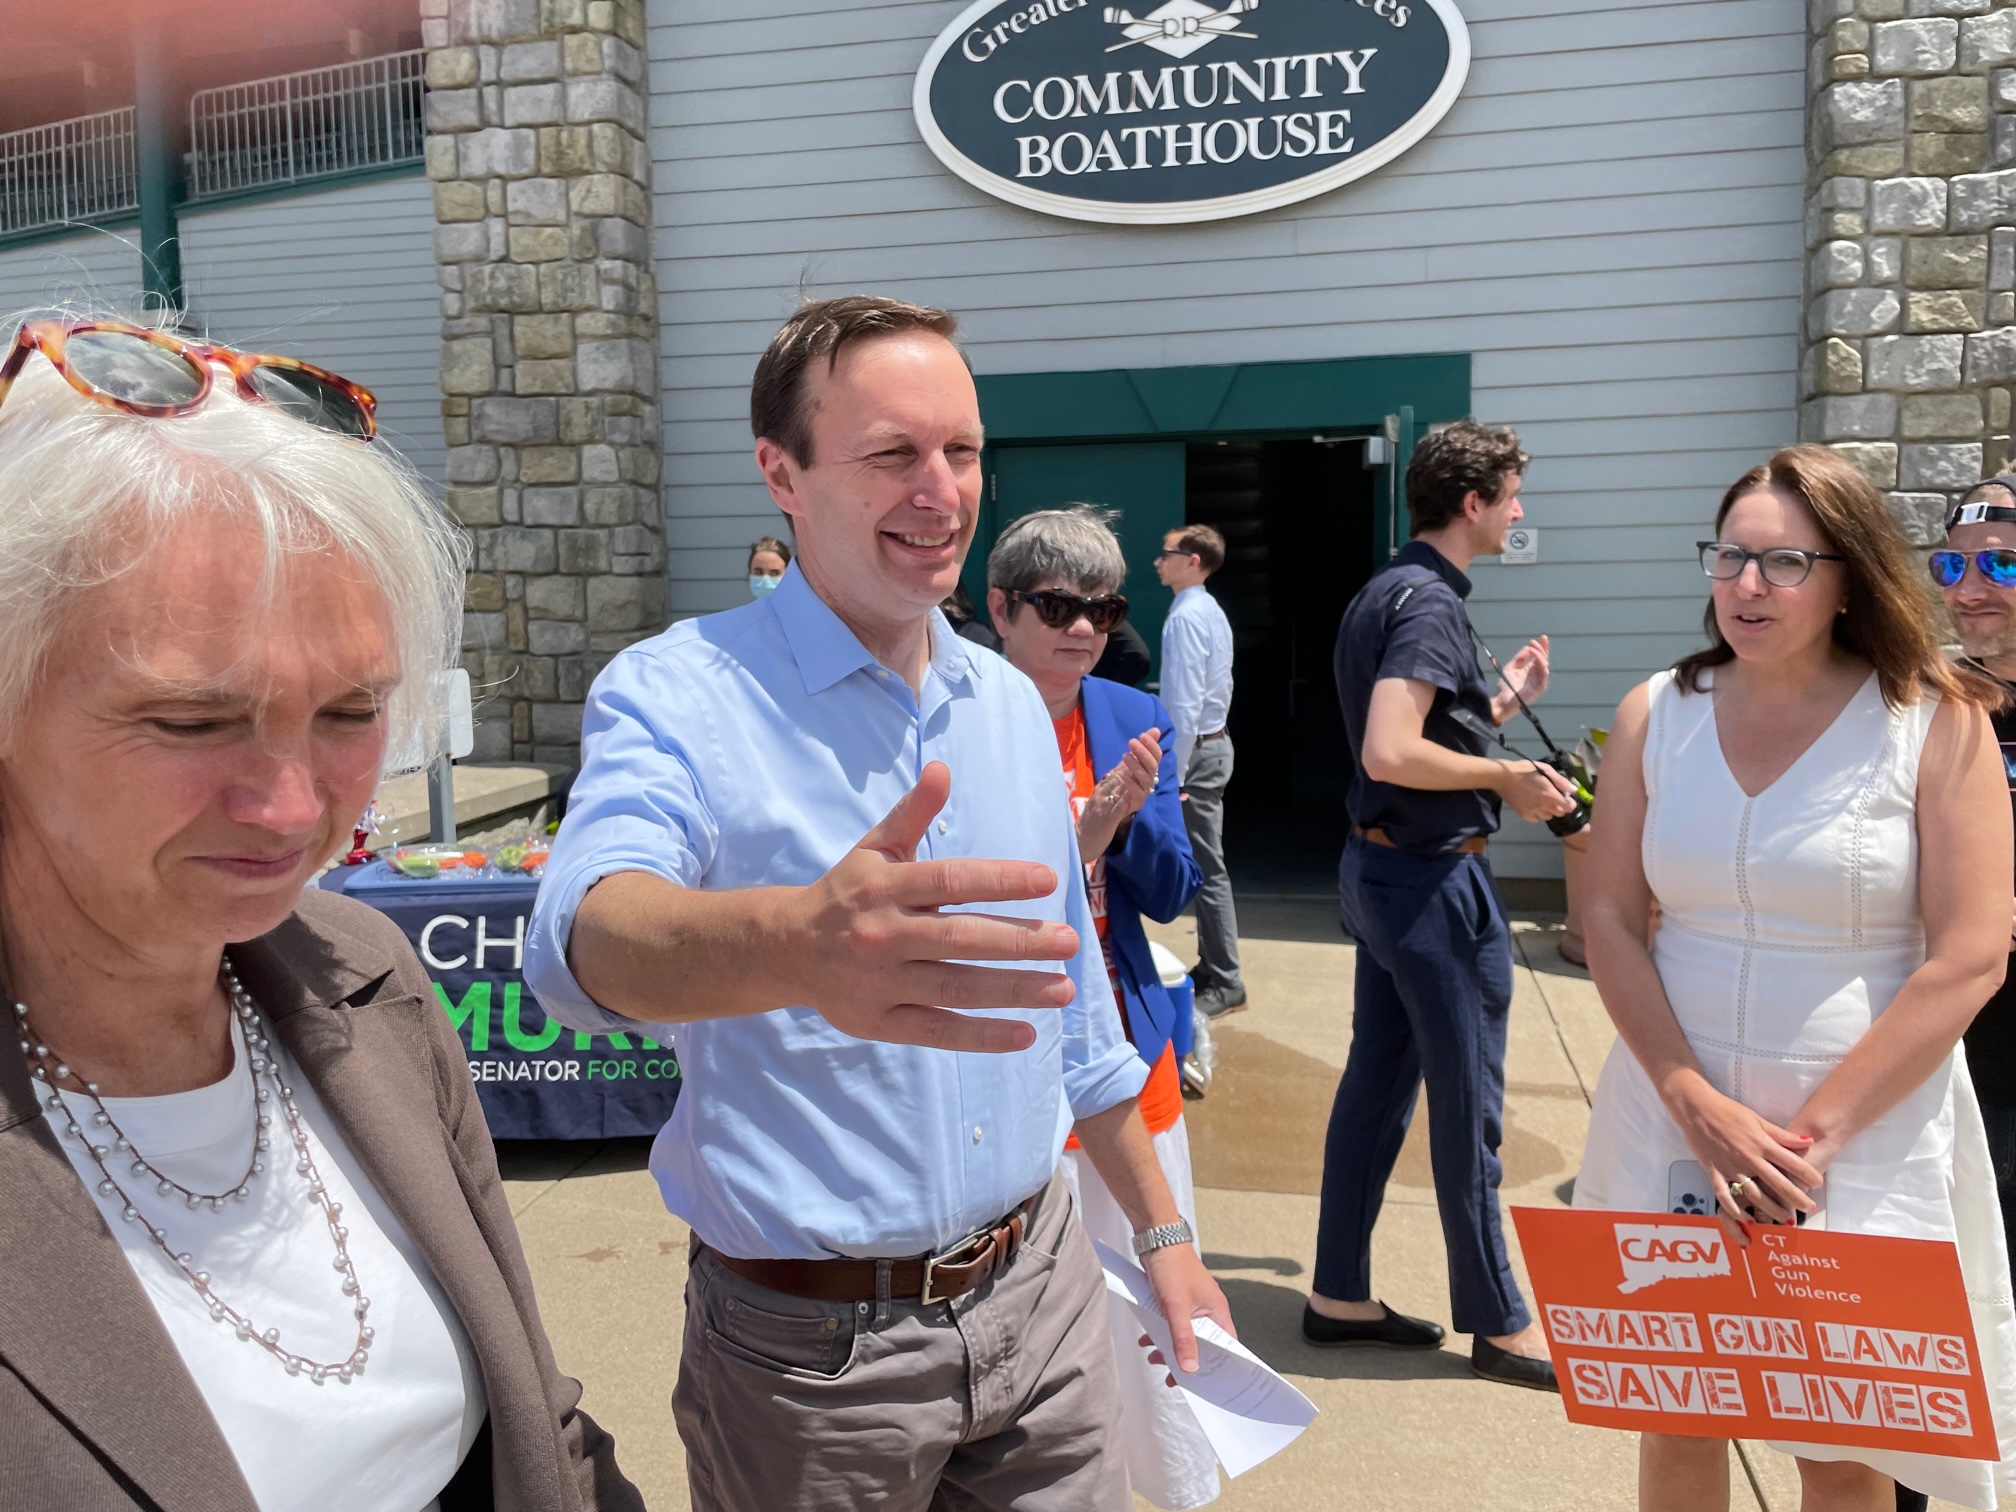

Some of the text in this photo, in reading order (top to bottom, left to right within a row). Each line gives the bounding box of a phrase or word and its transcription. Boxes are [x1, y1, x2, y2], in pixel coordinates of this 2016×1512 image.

[992, 47, 1378, 124] COMMUNITY
[1015, 109, 1355, 178] BOATHOUSE
[432, 981, 660, 1052] MU
[470, 1058, 683, 1082] SENATOR FOR CO
[1620, 1237, 1722, 1265] CAGV
[1762, 1233, 1787, 1248] CT
[1768, 1250, 1841, 1270] Against
[1771, 1266, 1811, 1282] Gun
[1774, 1281, 1862, 1304] Violence
[1549, 1307, 1967, 1372] SMART GUN LAWS
[1574, 1361, 1970, 1431] SAVE LIVES
